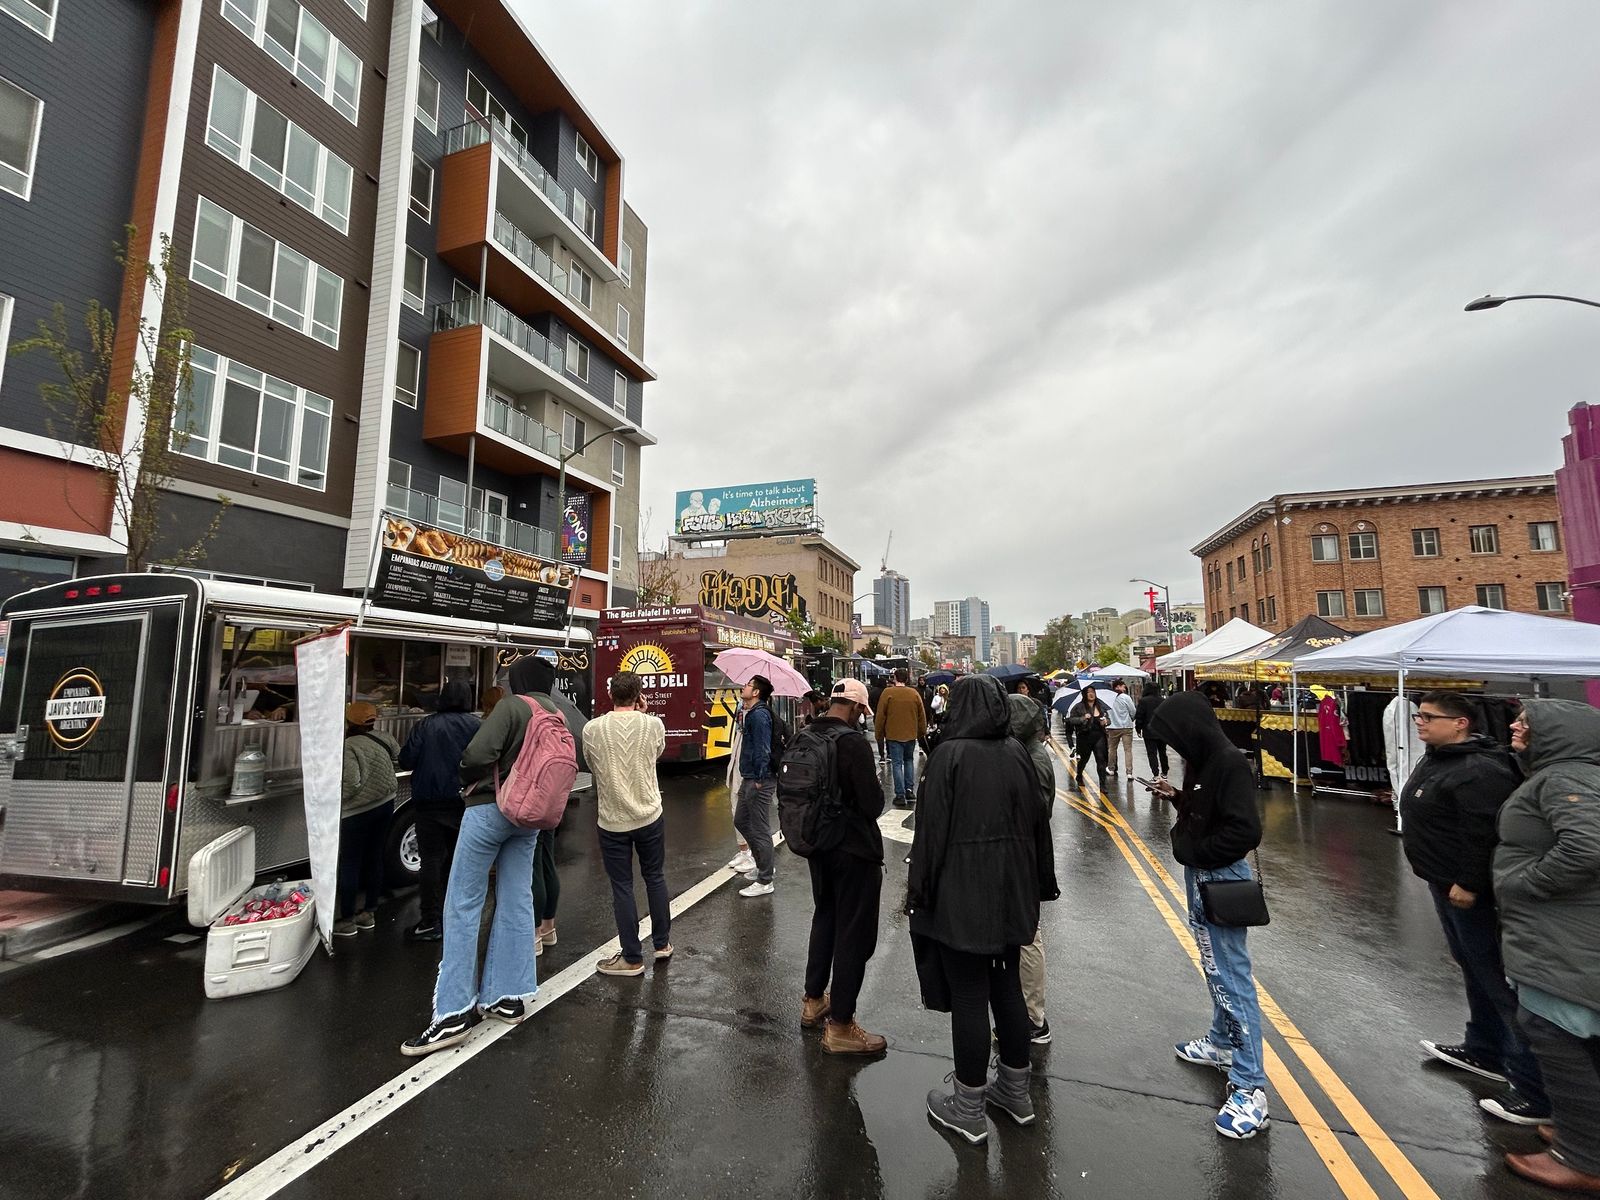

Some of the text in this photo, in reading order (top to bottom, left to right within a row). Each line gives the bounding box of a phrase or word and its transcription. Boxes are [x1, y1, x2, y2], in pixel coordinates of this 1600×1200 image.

[722, 491, 734, 500] It's
[736, 490, 753, 498] time
[765, 486, 780, 495] talk
[782, 485, 805, 494] about
[750, 494, 808, 508] Alzheimer's.
[564, 506, 588, 542] KONO
[391, 554, 420, 567] EMPANADAS
[420, 560, 449, 574] ARGENTINAS
[620, 610, 636, 618] Best
[638, 608, 660, 618] Falafel
[672, 607, 692, 615] Town
[660, 674, 688, 688] DELI
[48, 700, 102, 716] JAVI'S COOKING
